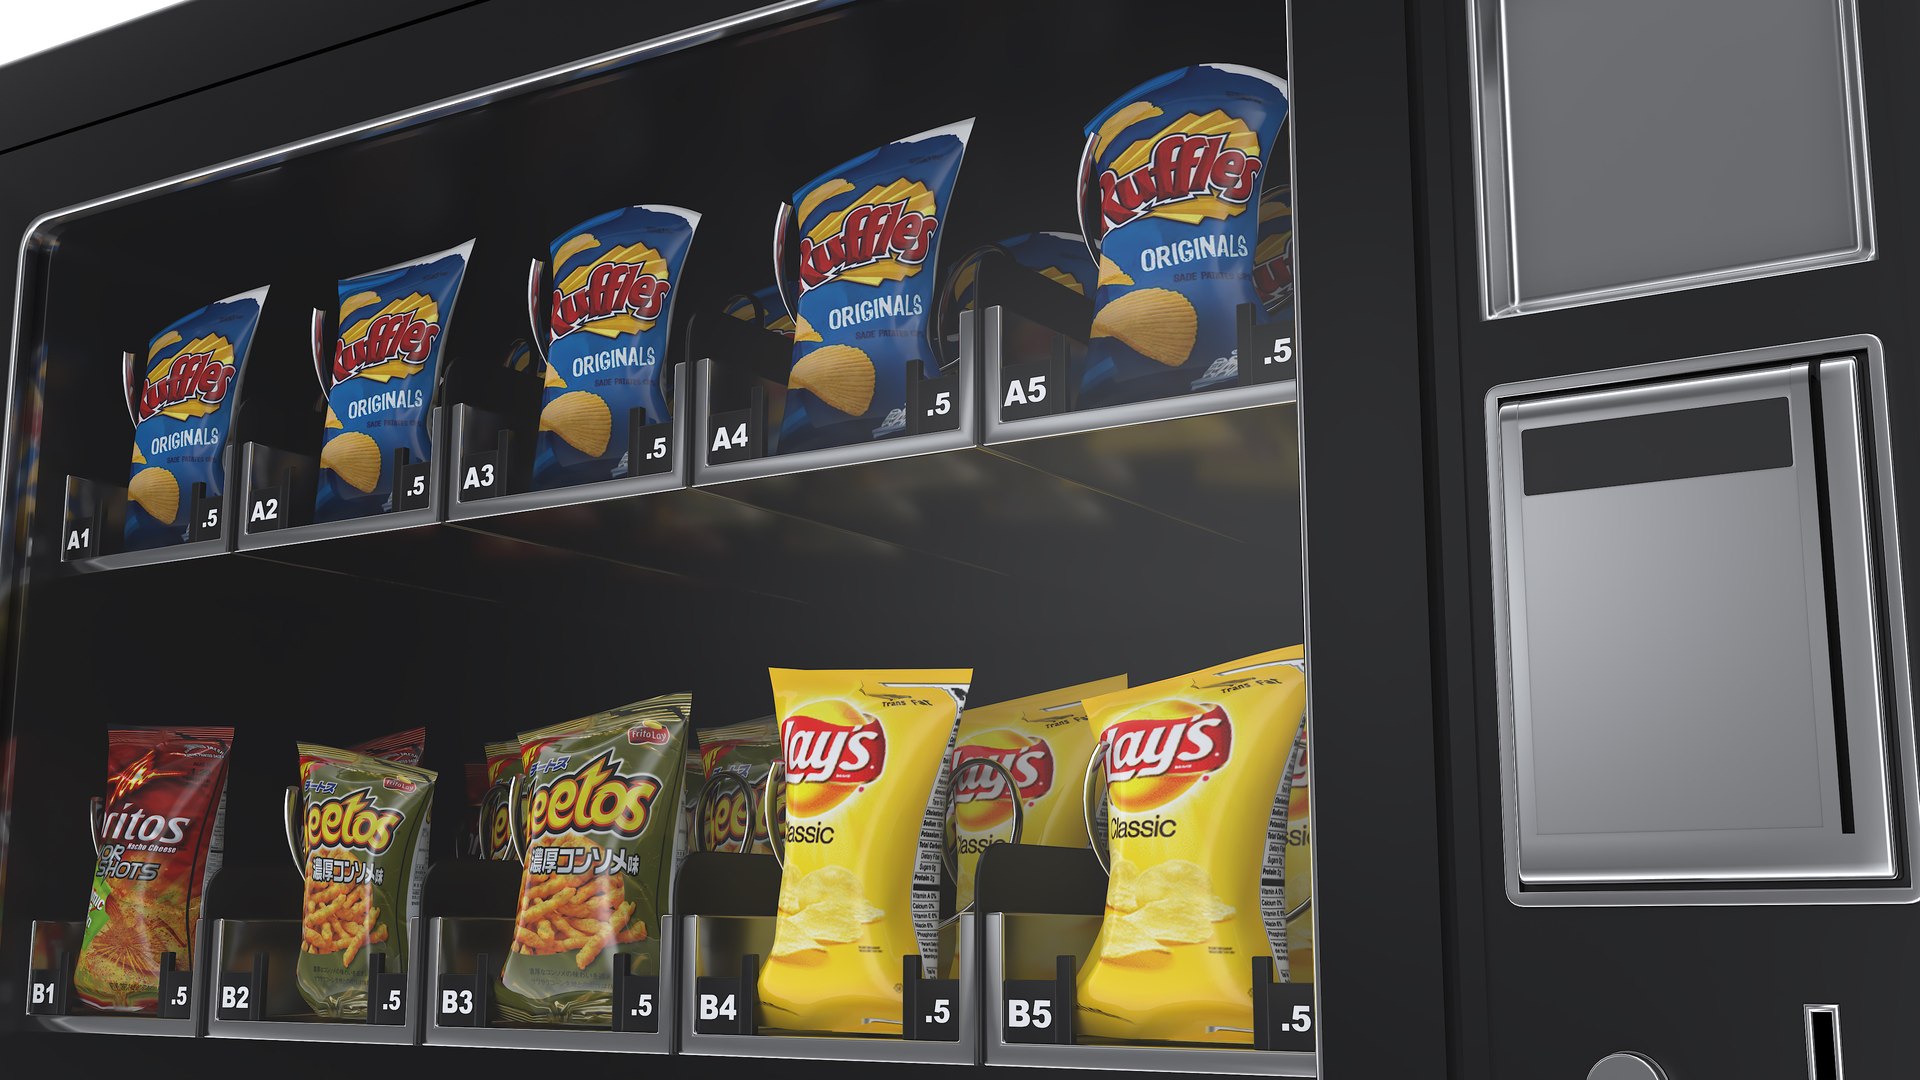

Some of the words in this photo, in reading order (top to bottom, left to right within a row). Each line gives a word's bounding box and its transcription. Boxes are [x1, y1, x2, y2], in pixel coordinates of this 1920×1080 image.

[1140, 234, 1248, 272] ORIGINALS
[828, 294, 923, 330] ORIGINALS
[572, 346, 656, 377] ORIGINALS
[1264, 338, 1291, 365] .5
[348, 389, 423, 419] ORIGINALS
[928, 392, 950, 416] .5
[1003, 376, 1047, 408] A5
[151, 428, 219, 455] ORIGINALS
[647, 437, 666, 459] .5
[712, 423, 748, 451] A4
[408, 476, 424, 496] .5
[463, 464, 494, 489] A3
[203, 509, 217, 527] .5
[251, 499, 277, 522] A2
[67, 529, 89, 551] A1
[1102, 714, 1222, 783] Lay's
[102, 803, 190, 843] ritos
[1111, 815, 1176, 840] Classic
[127, 843, 147, 851] Nacho
[148, 843, 177, 854] Cheese
[529, 847, 640, 876] 濃厚コンソメ味
[96, 860, 161, 880] SHOTS
[312, 857, 384, 885] 濃厚コンソメ味
[33, 983, 54, 1004] B1
[172, 987, 187, 1006] .5
[222, 987, 249, 1009] B2
[383, 989, 400, 1011] .5
[443, 987, 473, 1015] B3
[631, 994, 653, 1017] .5
[700, 994, 737, 1021] B4
[925, 999, 951, 1024] .5
[1008, 999, 1052, 1029] B5
[1282, 1005, 1311, 1033] .5
